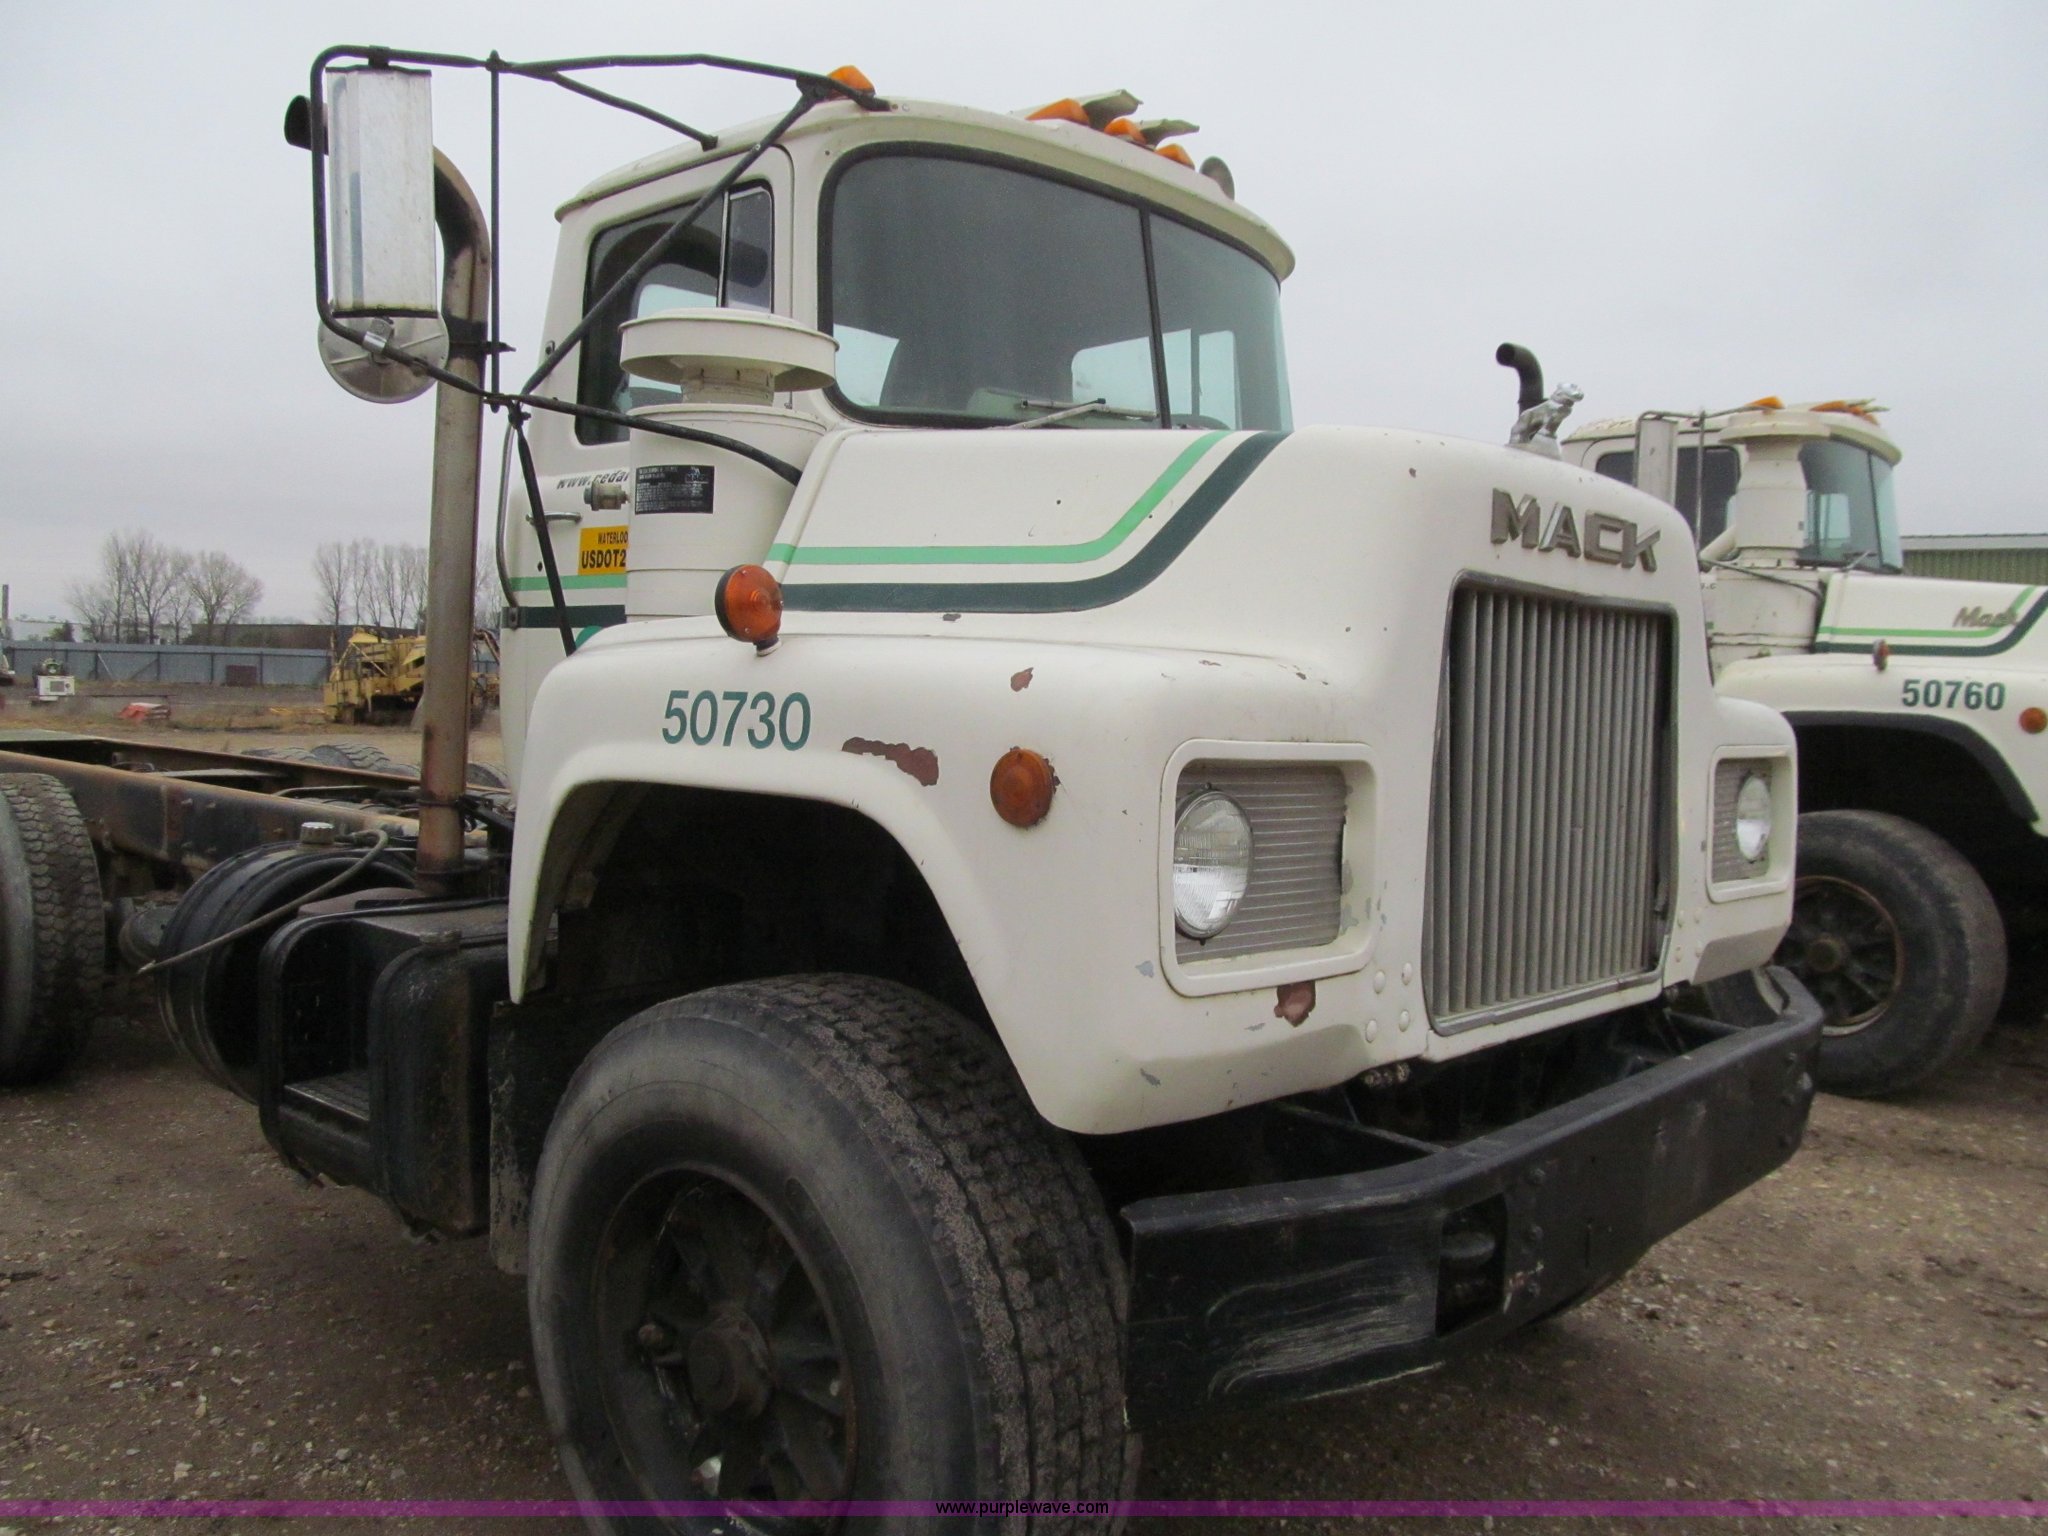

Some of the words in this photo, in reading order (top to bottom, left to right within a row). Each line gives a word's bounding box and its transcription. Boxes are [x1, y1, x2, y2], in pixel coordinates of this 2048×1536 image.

[1490, 488, 1661, 573] MACK
[581, 548, 627, 569] USDOT2
[1902, 678, 2006, 711] 50760
[662, 689, 811, 751] 50730
